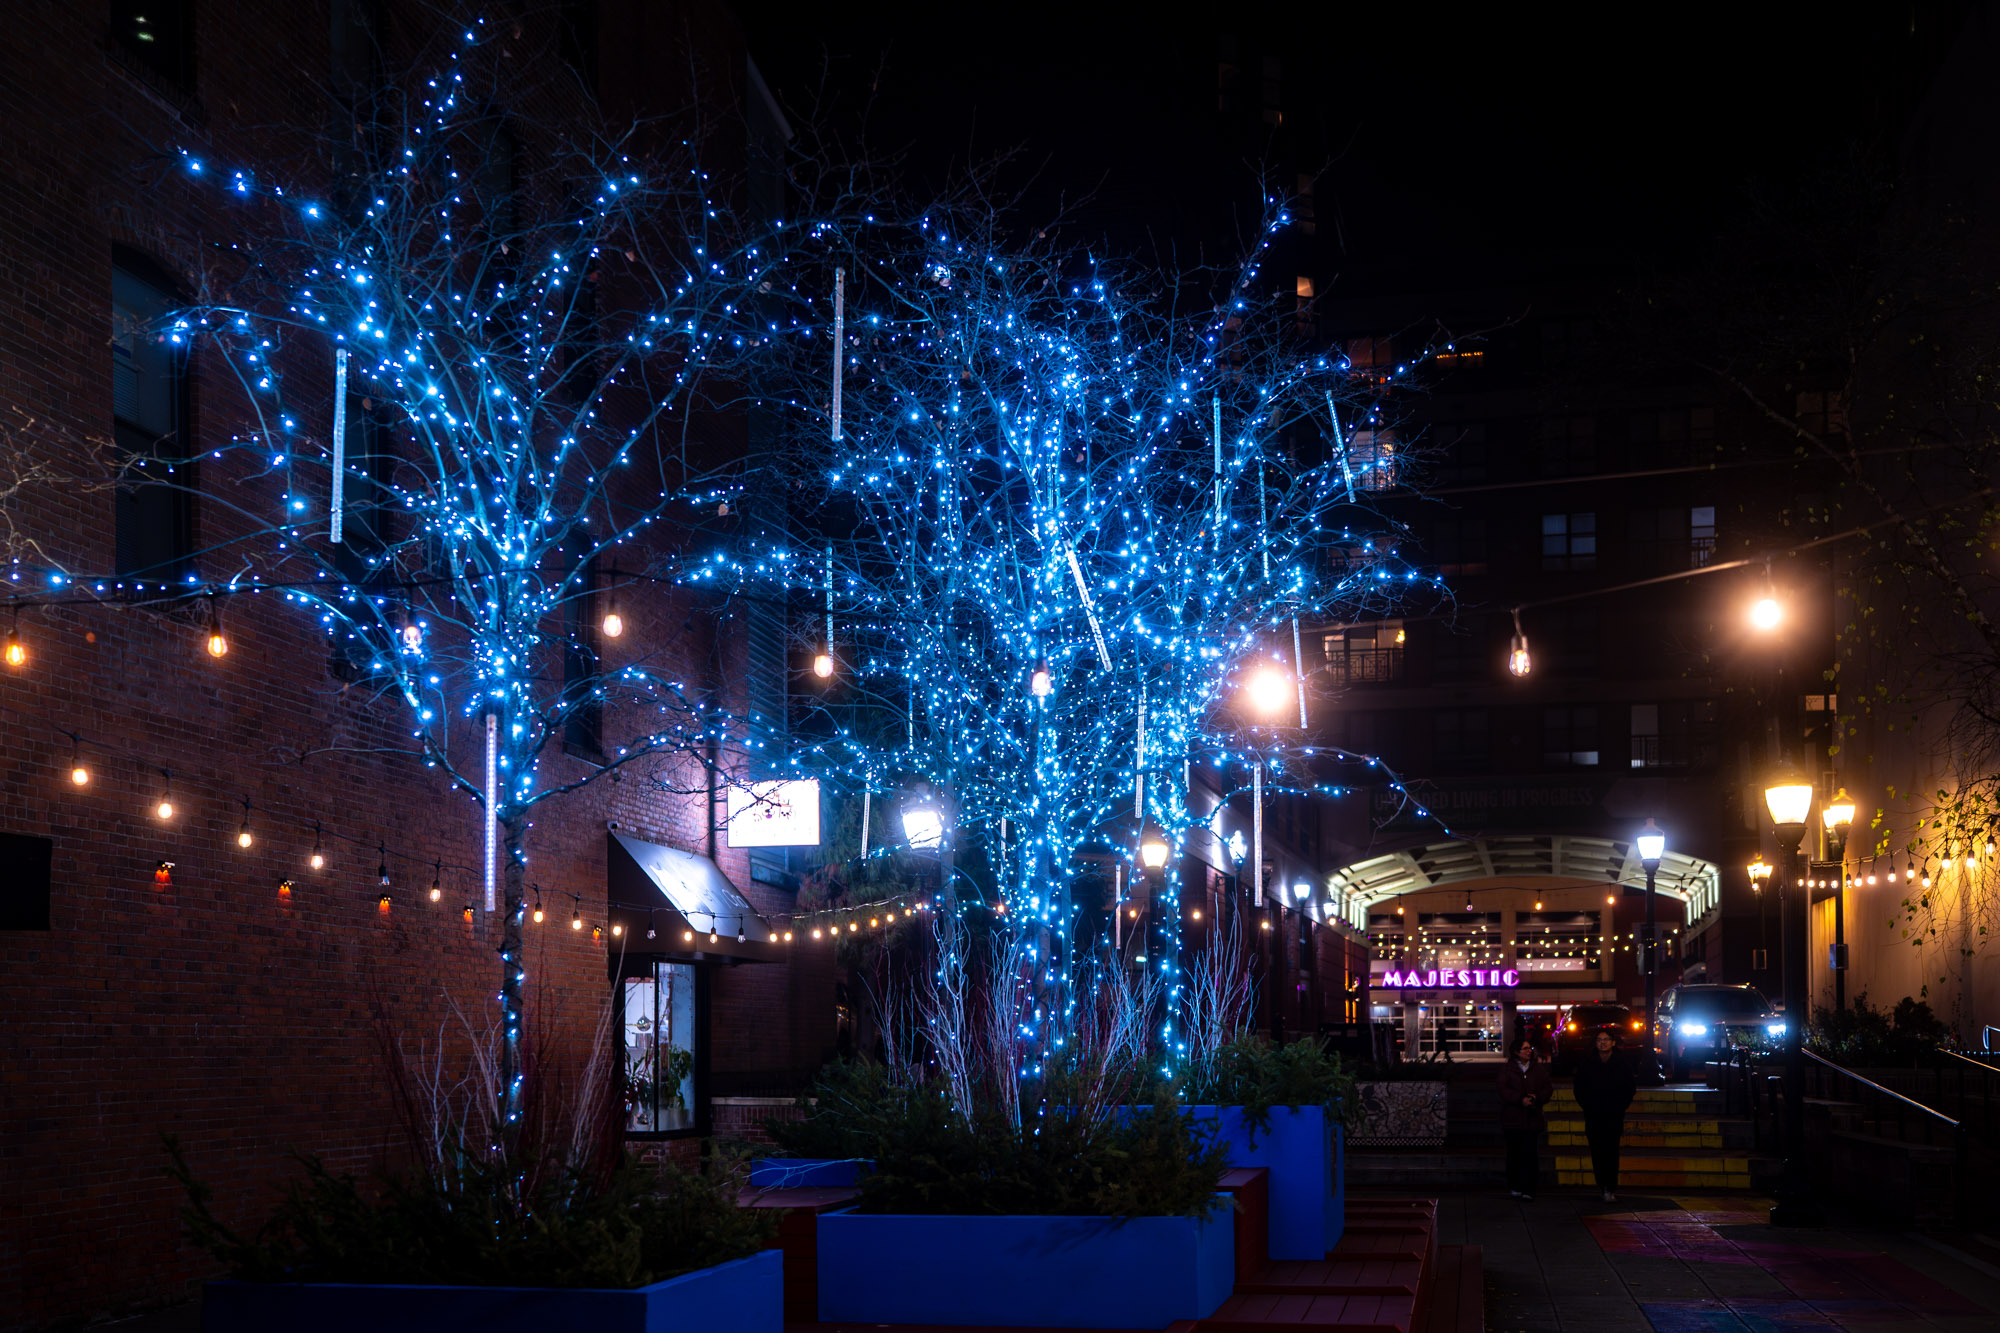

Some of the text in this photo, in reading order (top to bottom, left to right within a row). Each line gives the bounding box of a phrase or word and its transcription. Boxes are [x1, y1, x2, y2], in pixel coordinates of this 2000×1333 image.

[1451, 790, 1497, 809] LIVING
[1520, 787, 1593, 808] PROGRESS
[1381, 969, 1520, 988] MAJESTIC
